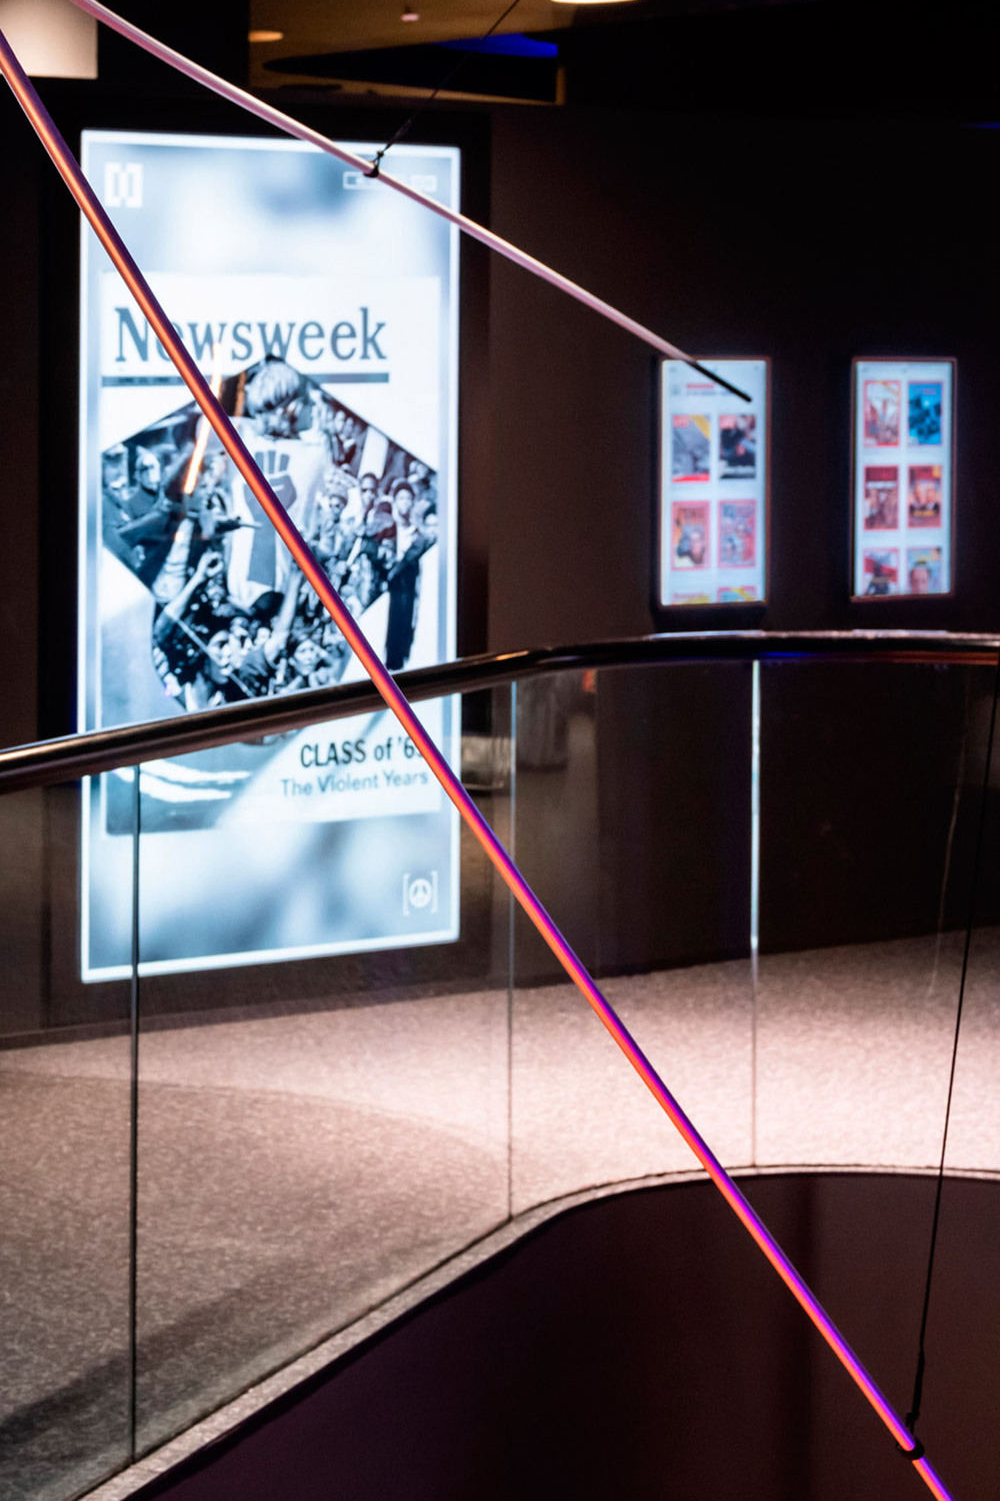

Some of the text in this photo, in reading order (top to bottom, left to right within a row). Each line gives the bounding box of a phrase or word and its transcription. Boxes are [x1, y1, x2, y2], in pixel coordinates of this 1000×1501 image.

[300, 739, 367, 768] CLASS
[374, 737, 393, 761] of
[281, 770, 429, 797] The Violent Years
